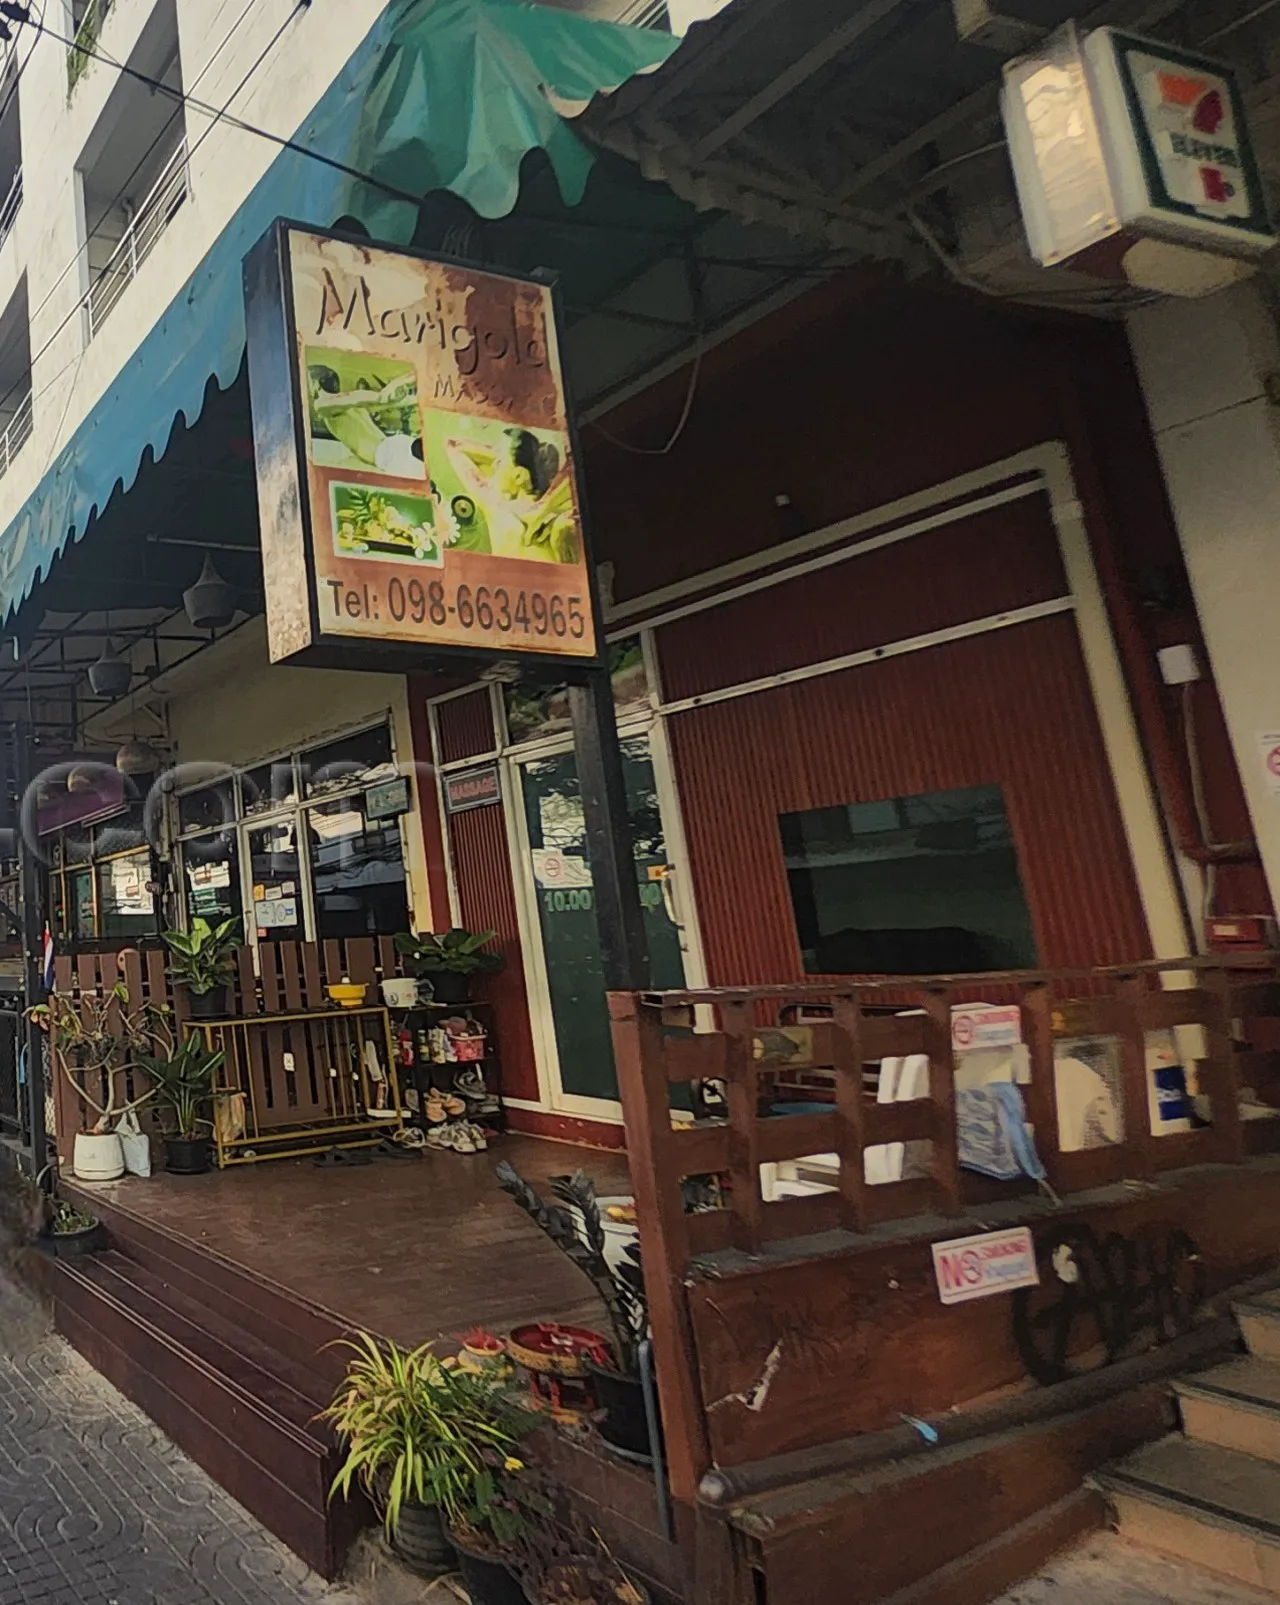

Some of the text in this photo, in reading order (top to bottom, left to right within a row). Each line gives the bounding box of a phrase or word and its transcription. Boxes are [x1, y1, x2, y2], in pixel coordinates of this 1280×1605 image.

[316, 266, 549, 376] Marigold
[327, 577, 585, 639] Tel: 098-6634965
[450, 776, 496, 801] MASSAGE
